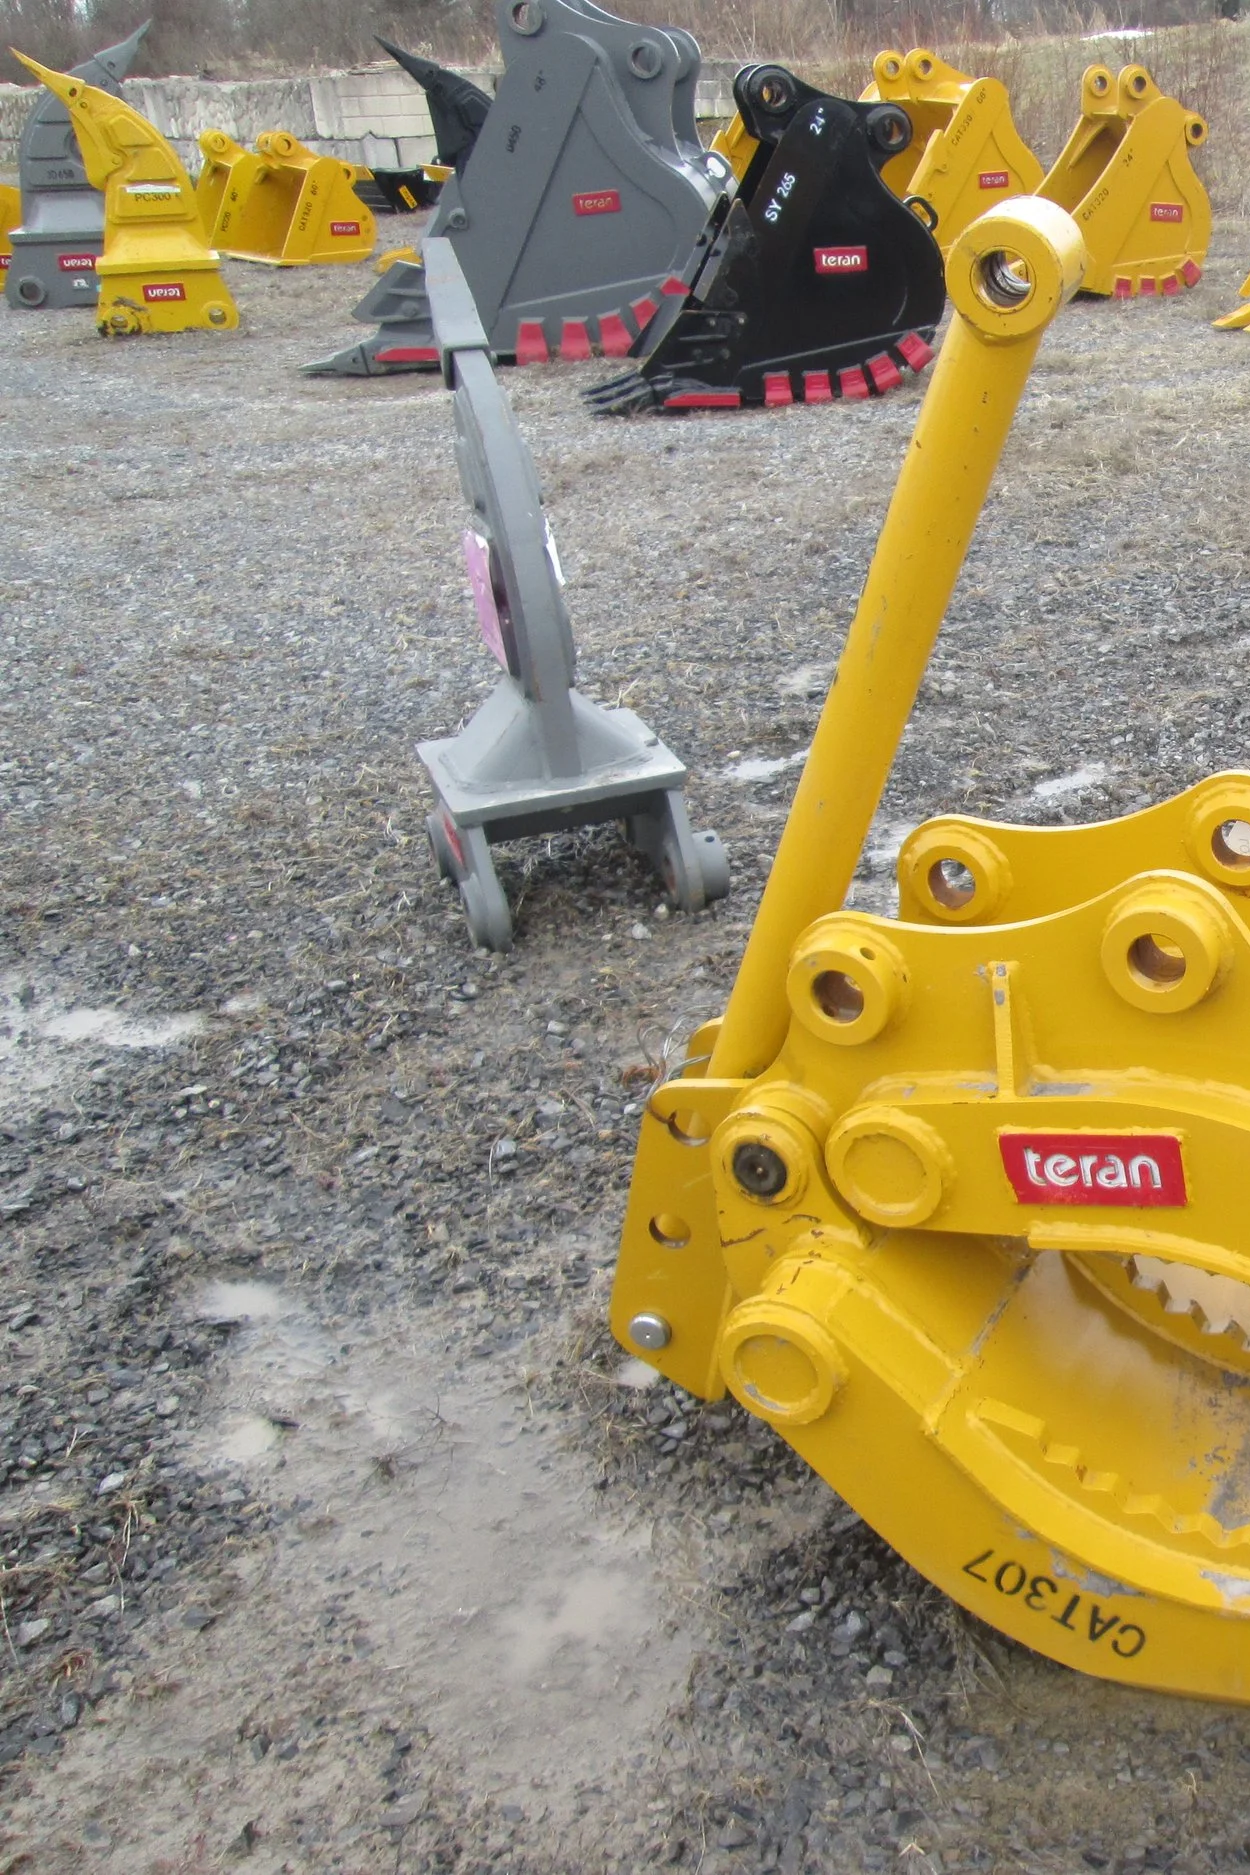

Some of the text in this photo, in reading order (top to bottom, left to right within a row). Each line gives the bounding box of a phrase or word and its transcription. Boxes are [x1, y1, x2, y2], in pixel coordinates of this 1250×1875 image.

[982, 175, 1005, 185] teran
[579, 196, 612, 210] teran
[764, 198, 782, 222] SY
[777, 172, 796, 198] 265
[1082, 188, 1109, 221] CAT320
[1153, 207, 1179, 217] teran
[333, 223, 357, 233] teran
[63, 258, 93, 267] teran
[821, 254, 861, 267] teran
[148, 287, 181, 298] teran
[1023, 1146, 1163, 1189] teran
[961, 1548, 1147, 1659] CAT307
